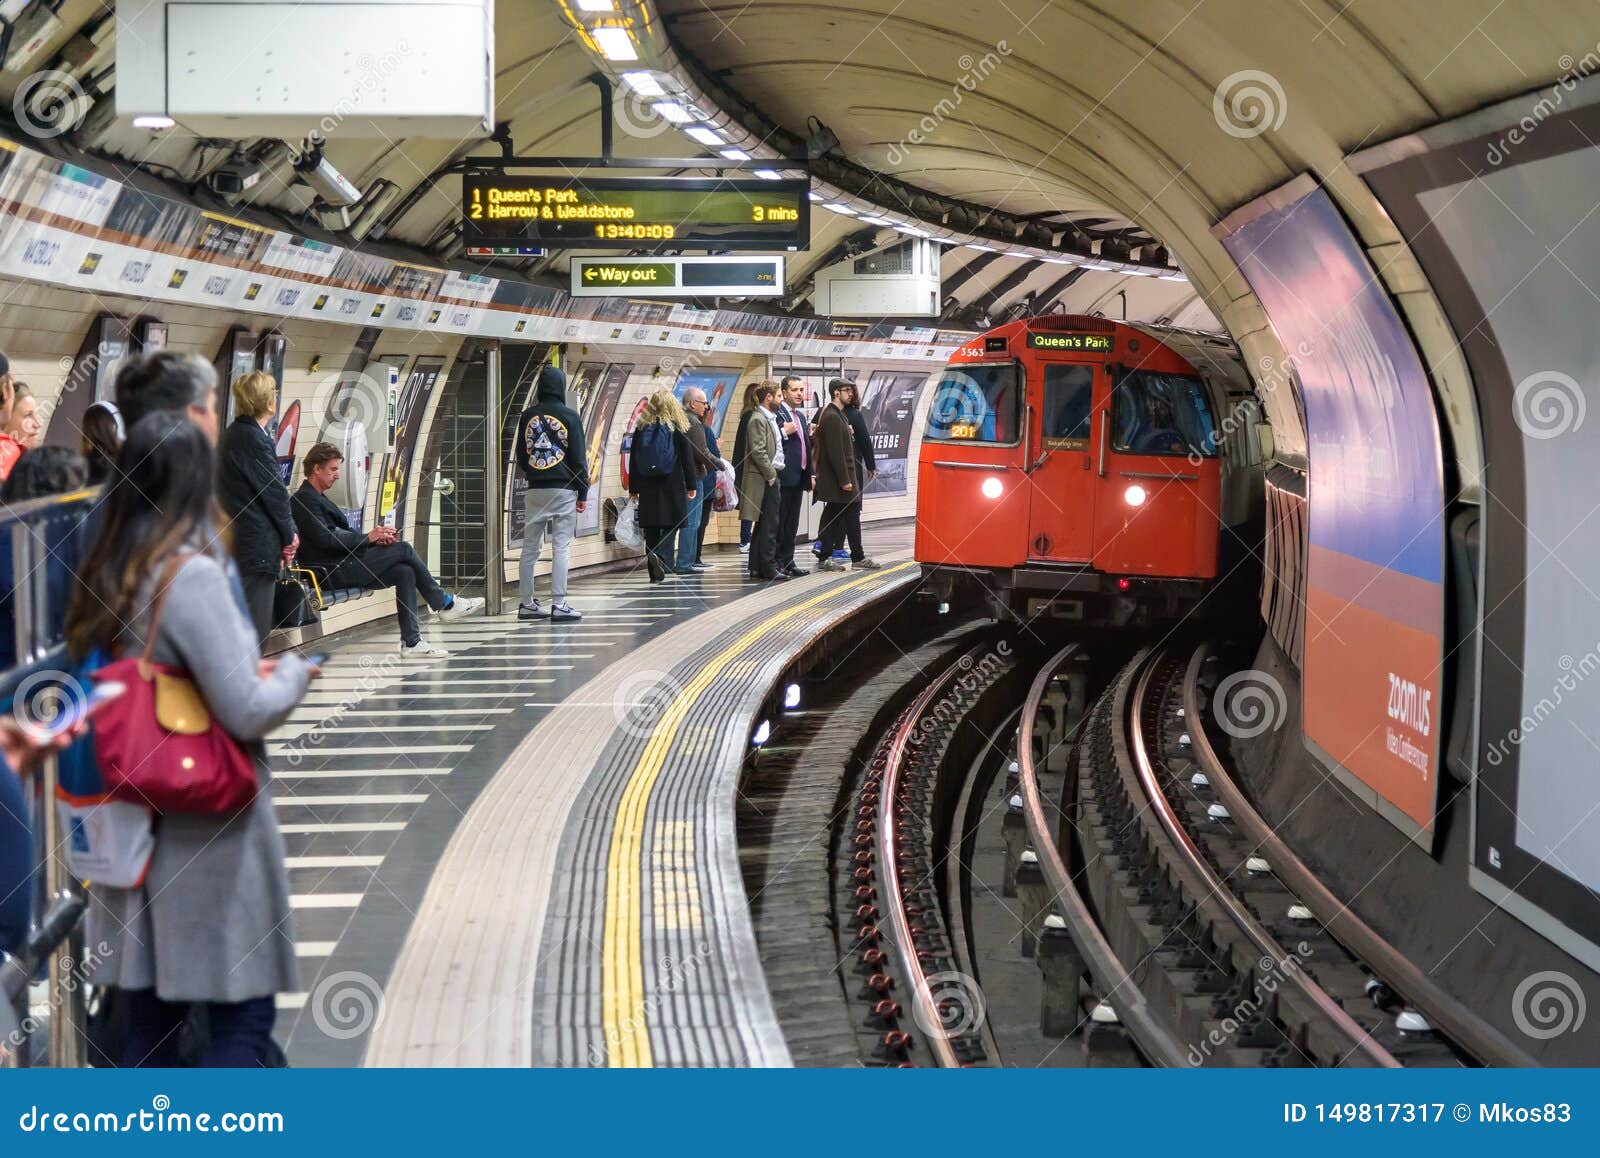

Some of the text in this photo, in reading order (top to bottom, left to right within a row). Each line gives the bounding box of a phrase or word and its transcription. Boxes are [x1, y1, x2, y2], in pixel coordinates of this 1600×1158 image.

[472, 188, 578, 203] 1 Queen's Park
[471, 203, 799, 222] 2 Harrow & Wealdstone 3 mins
[595, 224, 674, 239] 13:40:09
[600, 268, 657, 283] Way out
[1034, 335, 1110, 348] Queen's Park
[960, 347, 984, 357] 3563
[951, 424, 975, 438] 201
[1387, 672, 1431, 736] zoom.us
